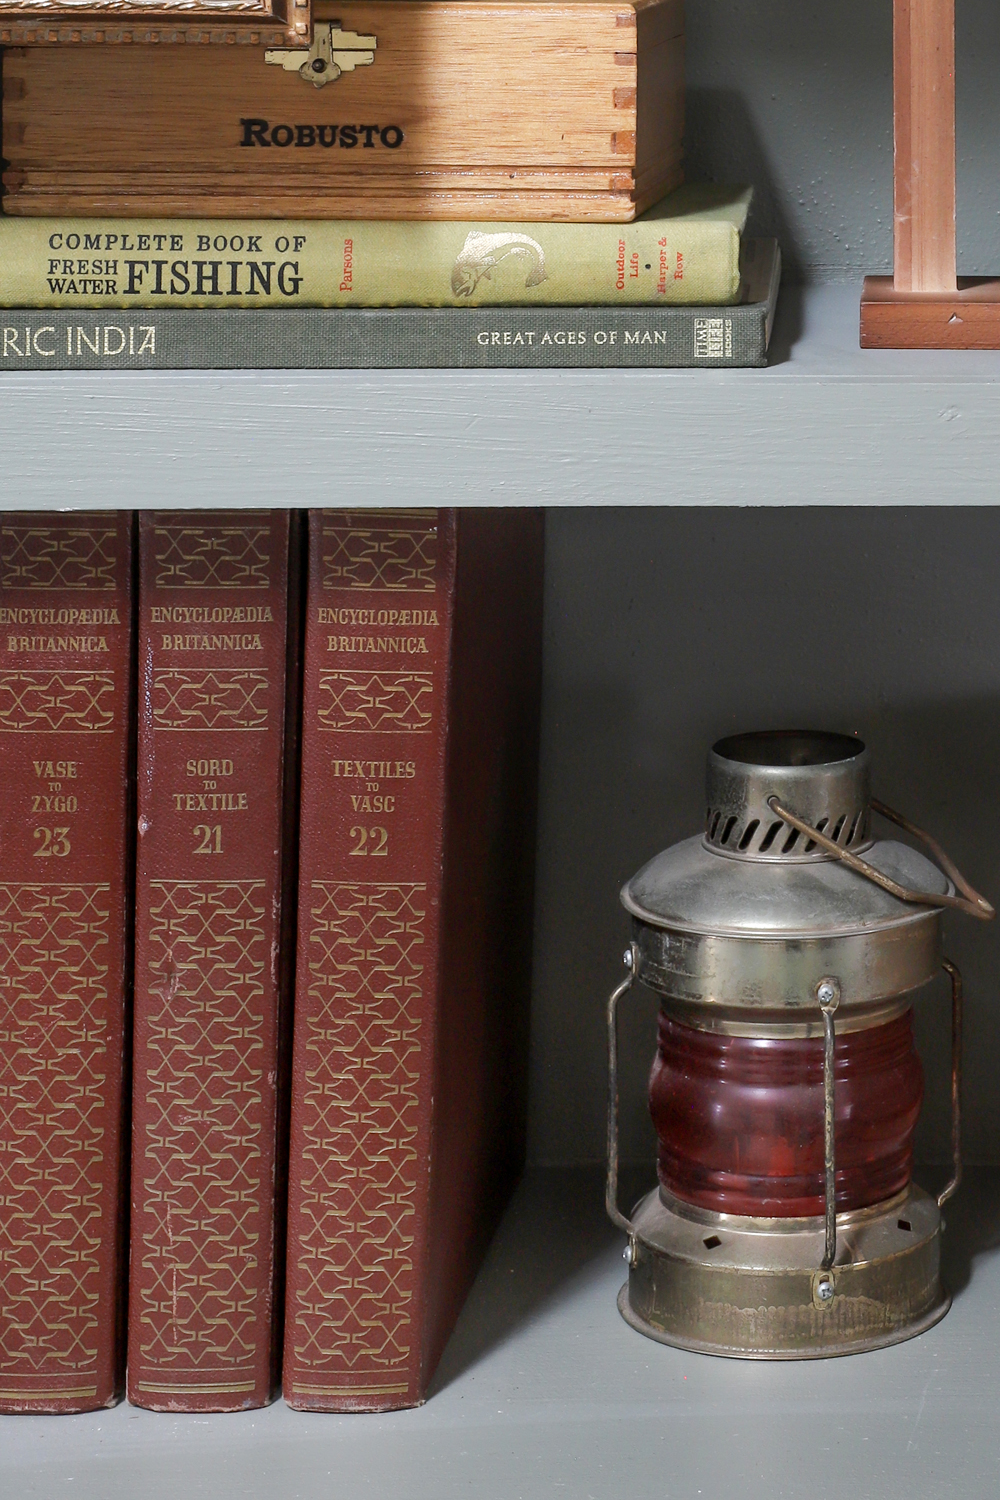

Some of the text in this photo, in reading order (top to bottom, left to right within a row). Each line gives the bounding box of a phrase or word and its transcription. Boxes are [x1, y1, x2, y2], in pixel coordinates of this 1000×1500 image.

[48, 233, 307, 252] COMPLETE BOOK OF
[47, 258, 119, 276] FRESH
[339, 238, 354, 292] Parsons
[615, 238, 626, 290] Outdoor
[629, 252, 640, 278] Life
[657, 236, 669, 294] Harper &
[673, 251, 684, 280] Row
[46, 277, 119, 296] WATER
[122, 259, 305, 297] FISHING
[3, 326, 156, 357] RIC INDIA
[476, 330, 668, 346] GREAT AGES OF MAN
[694, 317, 708, 358] TIME
[724, 318, 733, 358] BOOKS
[0, 606, 121, 625] ENCYCLOPÆDIA
[151, 606, 274, 625] ENCYCLOPÆDIA
[317, 607, 440, 627] ENCYCLOPÆDIA
[7, 635, 110, 653] BRITANNICA
[161, 633, 264, 652] BRITANNICA
[326, 635, 429, 654] BRITANNICA
[33, 761, 78, 779] VASE
[186, 759, 234, 778] SORD
[332, 760, 416, 779] TEXTILES
[48, 781, 62, 793] TO
[203, 780, 217, 791] TO
[366, 781, 380, 793] TO
[31, 795, 78, 813] ZYGO
[173, 792, 249, 812] TEXTILE
[350, 794, 396, 813] VASC
[33, 826, 72, 858] 23
[192, 824, 225, 856] 21
[348, 826, 390, 857] 22
